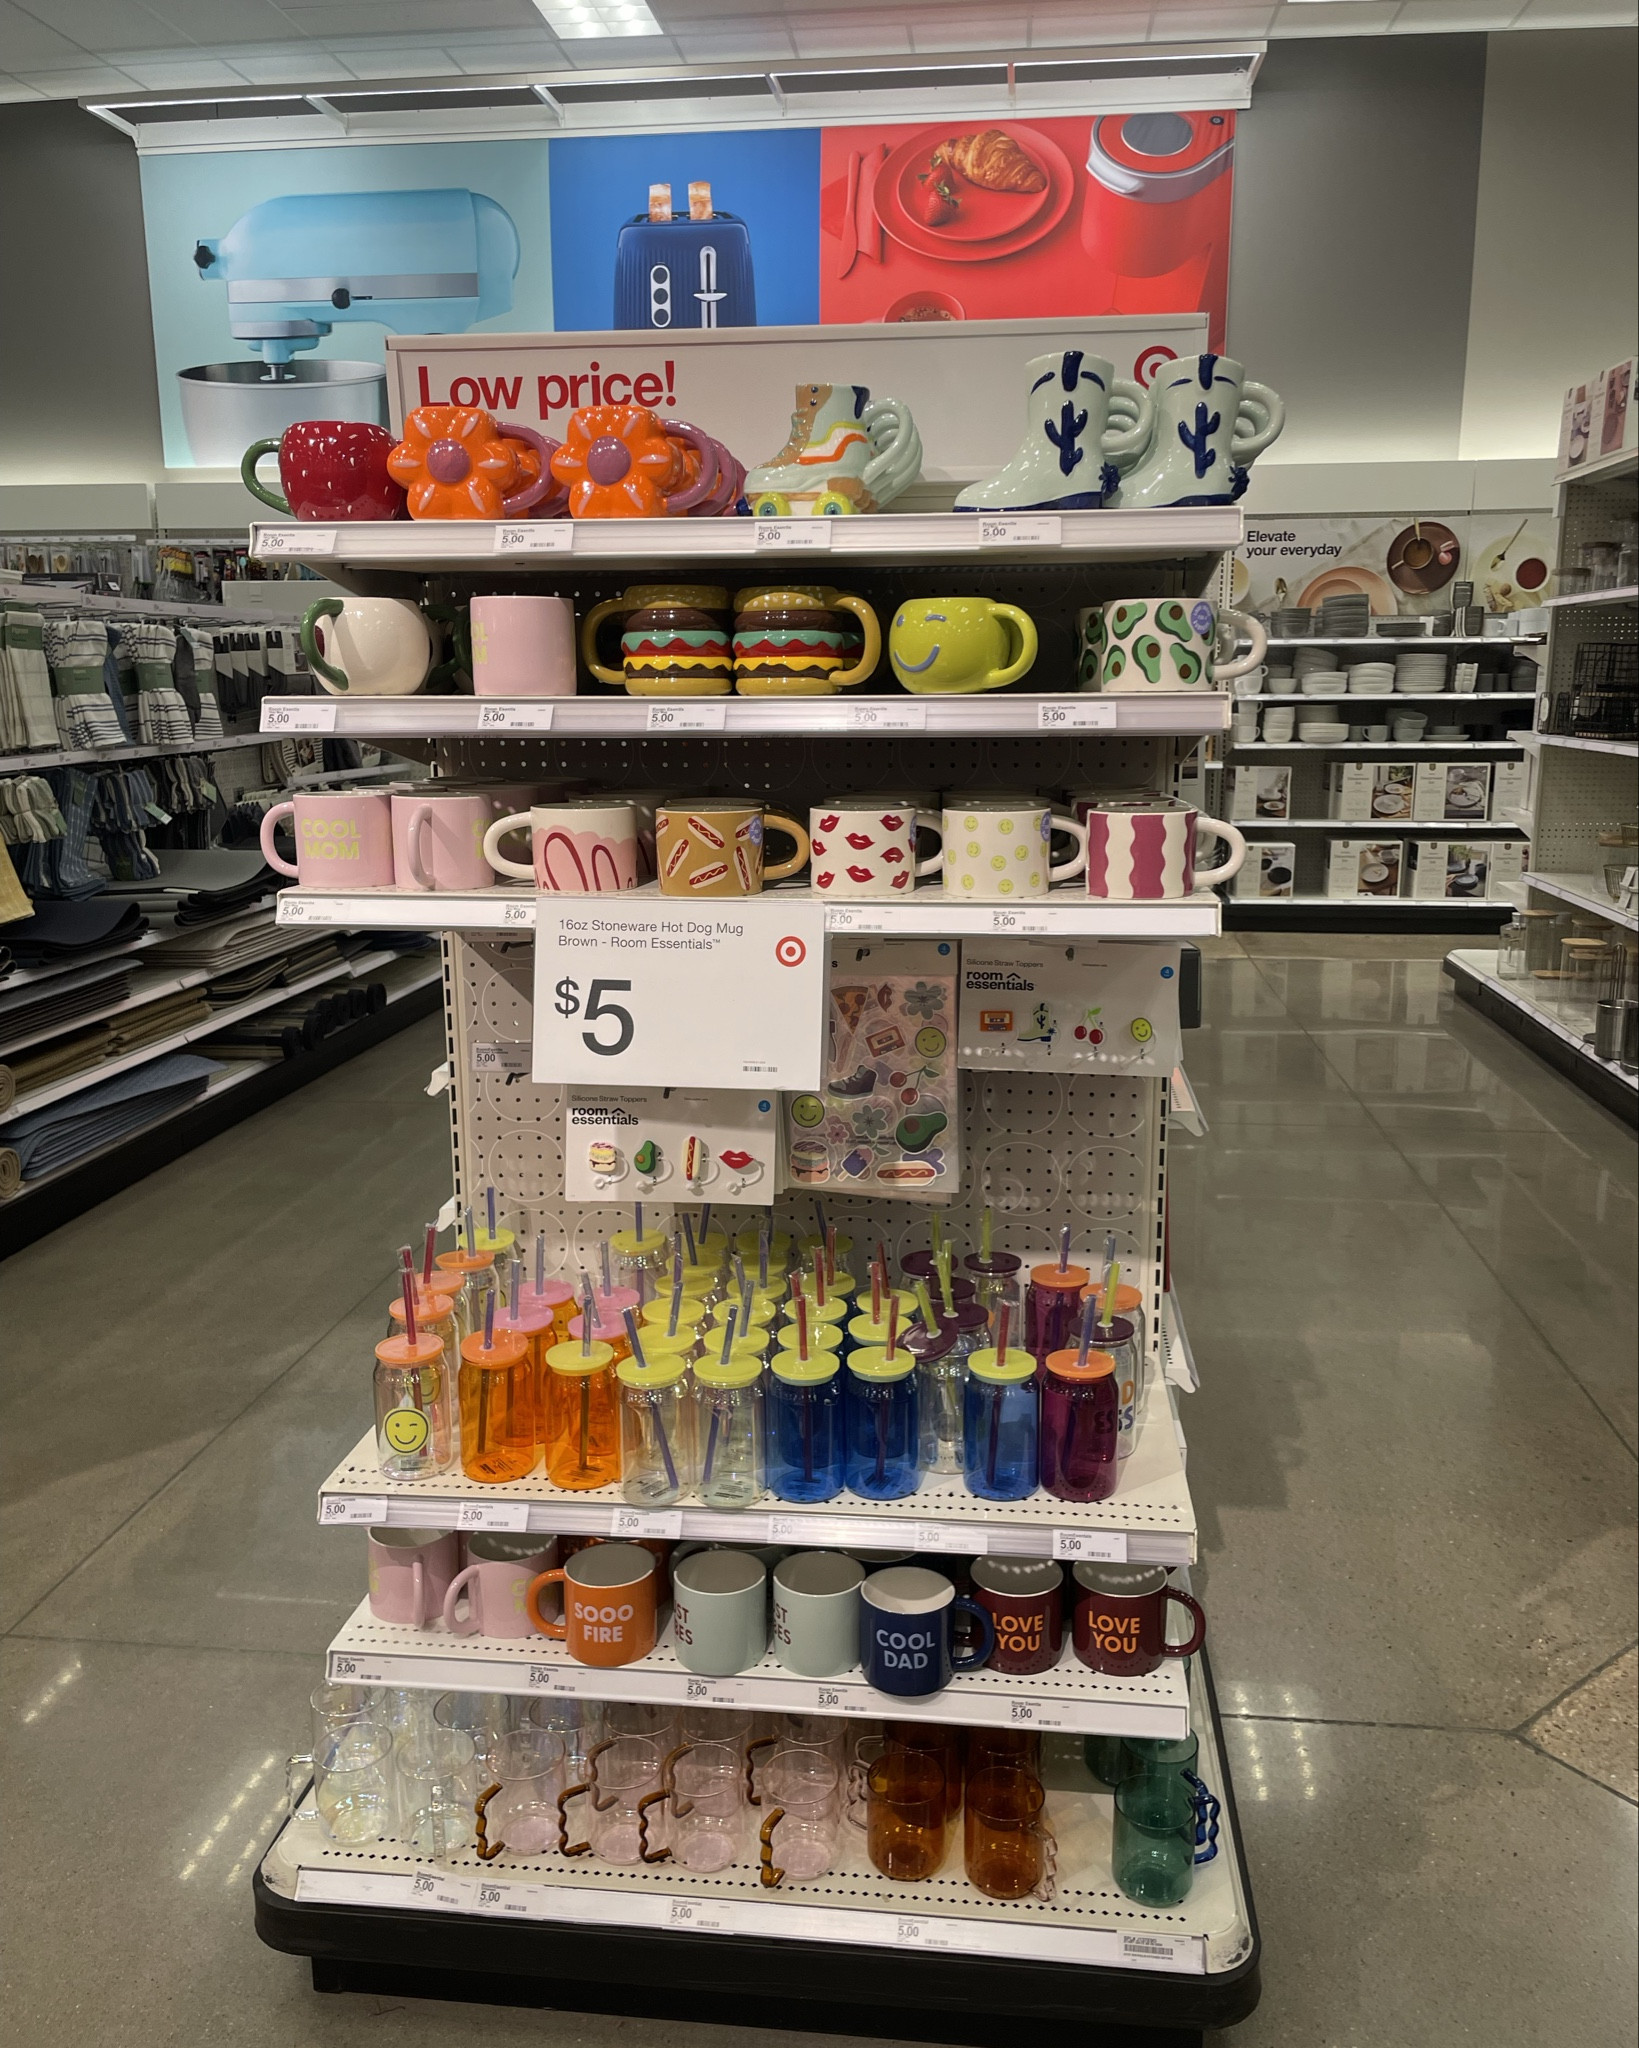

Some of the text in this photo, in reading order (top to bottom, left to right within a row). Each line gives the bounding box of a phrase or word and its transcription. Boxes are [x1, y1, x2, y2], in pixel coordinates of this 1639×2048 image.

[418, 361, 677, 419] Low price!
[758, 532, 780, 540] 5.00
[983, 528, 1006, 536] 5.00
[1247, 530, 1296, 542] Elevate
[262, 539, 284, 548] 5.00
[502, 535, 524, 544] 5.00
[1246, 544, 1342, 558] your everyday
[268, 714, 289, 723] 5.00
[652, 714, 673, 722] 5.00
[1042, 712, 1066, 720] 5.00
[302, 818, 362, 839] COOL
[304, 840, 360, 860] MOM
[282, 907, 303, 915] 5.00
[505, 910, 526, 919] 5.00
[831, 916, 852, 924] 5.00
[993, 917, 1015, 926] 5.00
[560, 920, 744, 936] 16oz Stoneware Hot Dog Mug
[558, 936, 598, 947] Brown
[611, 936, 647, 948] Room
[966, 971, 1003, 980] room
[966, 978, 1034, 991] essentials
[554, 976, 635, 1056] $5
[476, 1054, 495, 1062] 5.00
[620, 1096, 647, 1104] Toppers
[572, 1108, 608, 1116] room
[572, 1114, 639, 1126] essentials
[326, 1504, 345, 1514] 5.00
[462, 1511, 482, 1520] 5.00
[618, 1518, 638, 1527] 5.00
[1060, 1540, 1081, 1549] 5.00
[574, 1602, 634, 1624] SOOO
[992, 1613, 1044, 1634] LOVE
[1088, 1610, 1140, 1634] LOVE
[584, 1625, 623, 1643] FIRE
[876, 1628, 936, 1650] COOL
[998, 1632, 1040, 1652] YOU
[1092, 1632, 1138, 1654] YOU
[884, 1652, 928, 1670] DAD
[337, 1664, 356, 1673] 5.00
[530, 1673, 549, 1683] 5.00
[687, 1686, 707, 1695] 5.00
[818, 1694, 838, 1704] 5.00
[1012, 1708, 1032, 1718] 5.00
[414, 1879, 434, 1891] 5.00
[480, 1890, 500, 1902] 5.00
[672, 1907, 692, 1918] 5.00
[898, 1926, 919, 1936] 5.00
